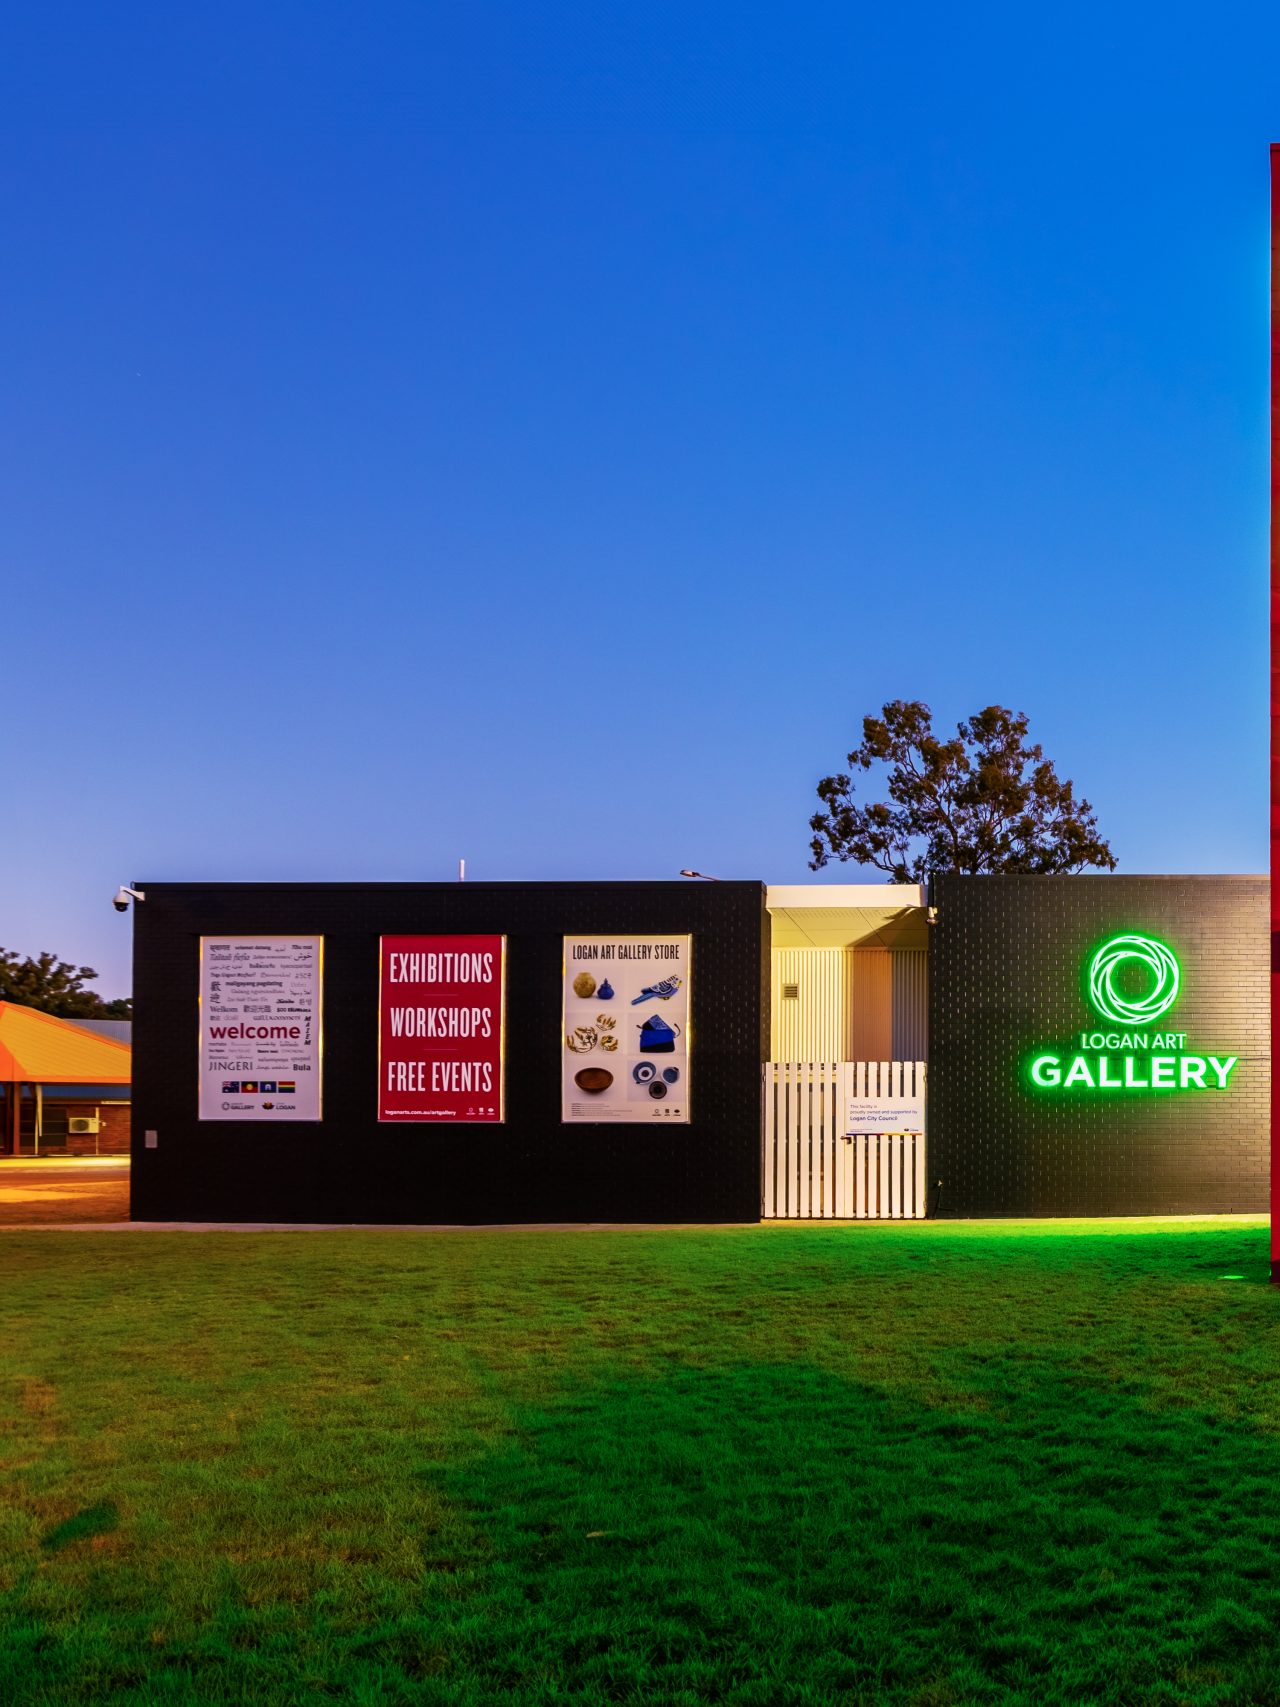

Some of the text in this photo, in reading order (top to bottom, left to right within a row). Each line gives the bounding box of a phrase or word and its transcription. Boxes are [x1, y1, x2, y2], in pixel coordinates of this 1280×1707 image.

[572, 944, 680, 960] LOGAN ART GALLERY STORE
[389, 952, 493, 983] EXHIBITIONS
[209, 1022, 301, 1039] welcome
[390, 1007, 492, 1038] WORKSHOPS
[1082, 1033, 1187, 1049] LOGAN ART
[208, 1061, 253, 1071] JINGERI
[293, 1063, 311, 1071] Bula
[1031, 1055, 1238, 1088] GALLERY
[387, 1061, 493, 1093] FREE EVENTS
